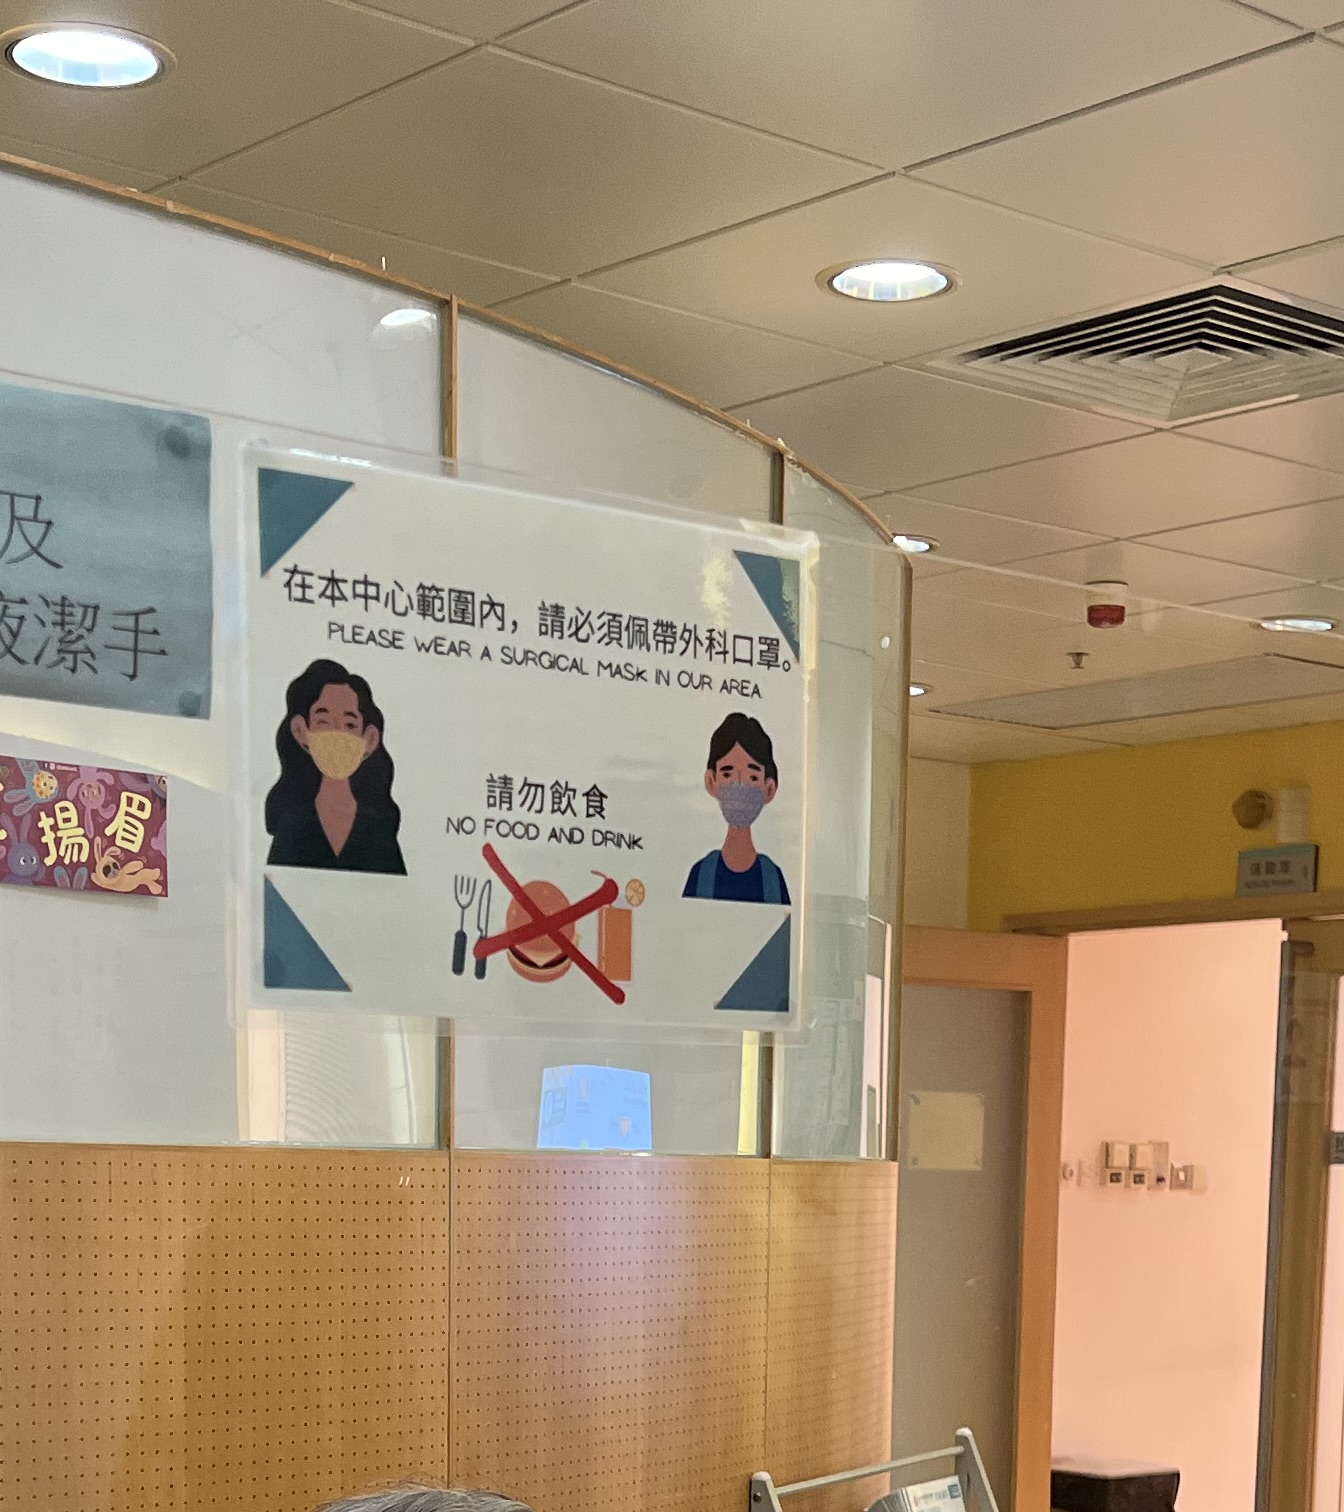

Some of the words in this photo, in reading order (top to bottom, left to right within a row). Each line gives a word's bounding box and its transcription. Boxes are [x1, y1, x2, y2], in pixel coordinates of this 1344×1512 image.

[327, 621, 405, 651] PLEASE
[414, 635, 472, 658] WEAR
[480, 647, 493, 662] A
[500, 645, 589, 676] SURGICAL
[597, 659, 648, 682] MASK
[655, 668, 671, 687] IN
[677, 670, 713, 691] OUR
[719, 678, 764, 699] AREA
[485, 772, 609, 820] 請勿飲食
[445, 816, 477, 835] NO
[483, 818, 540, 841] FOOD
[547, 826, 585, 845] AND
[591, 828, 644, 851] DRINK
